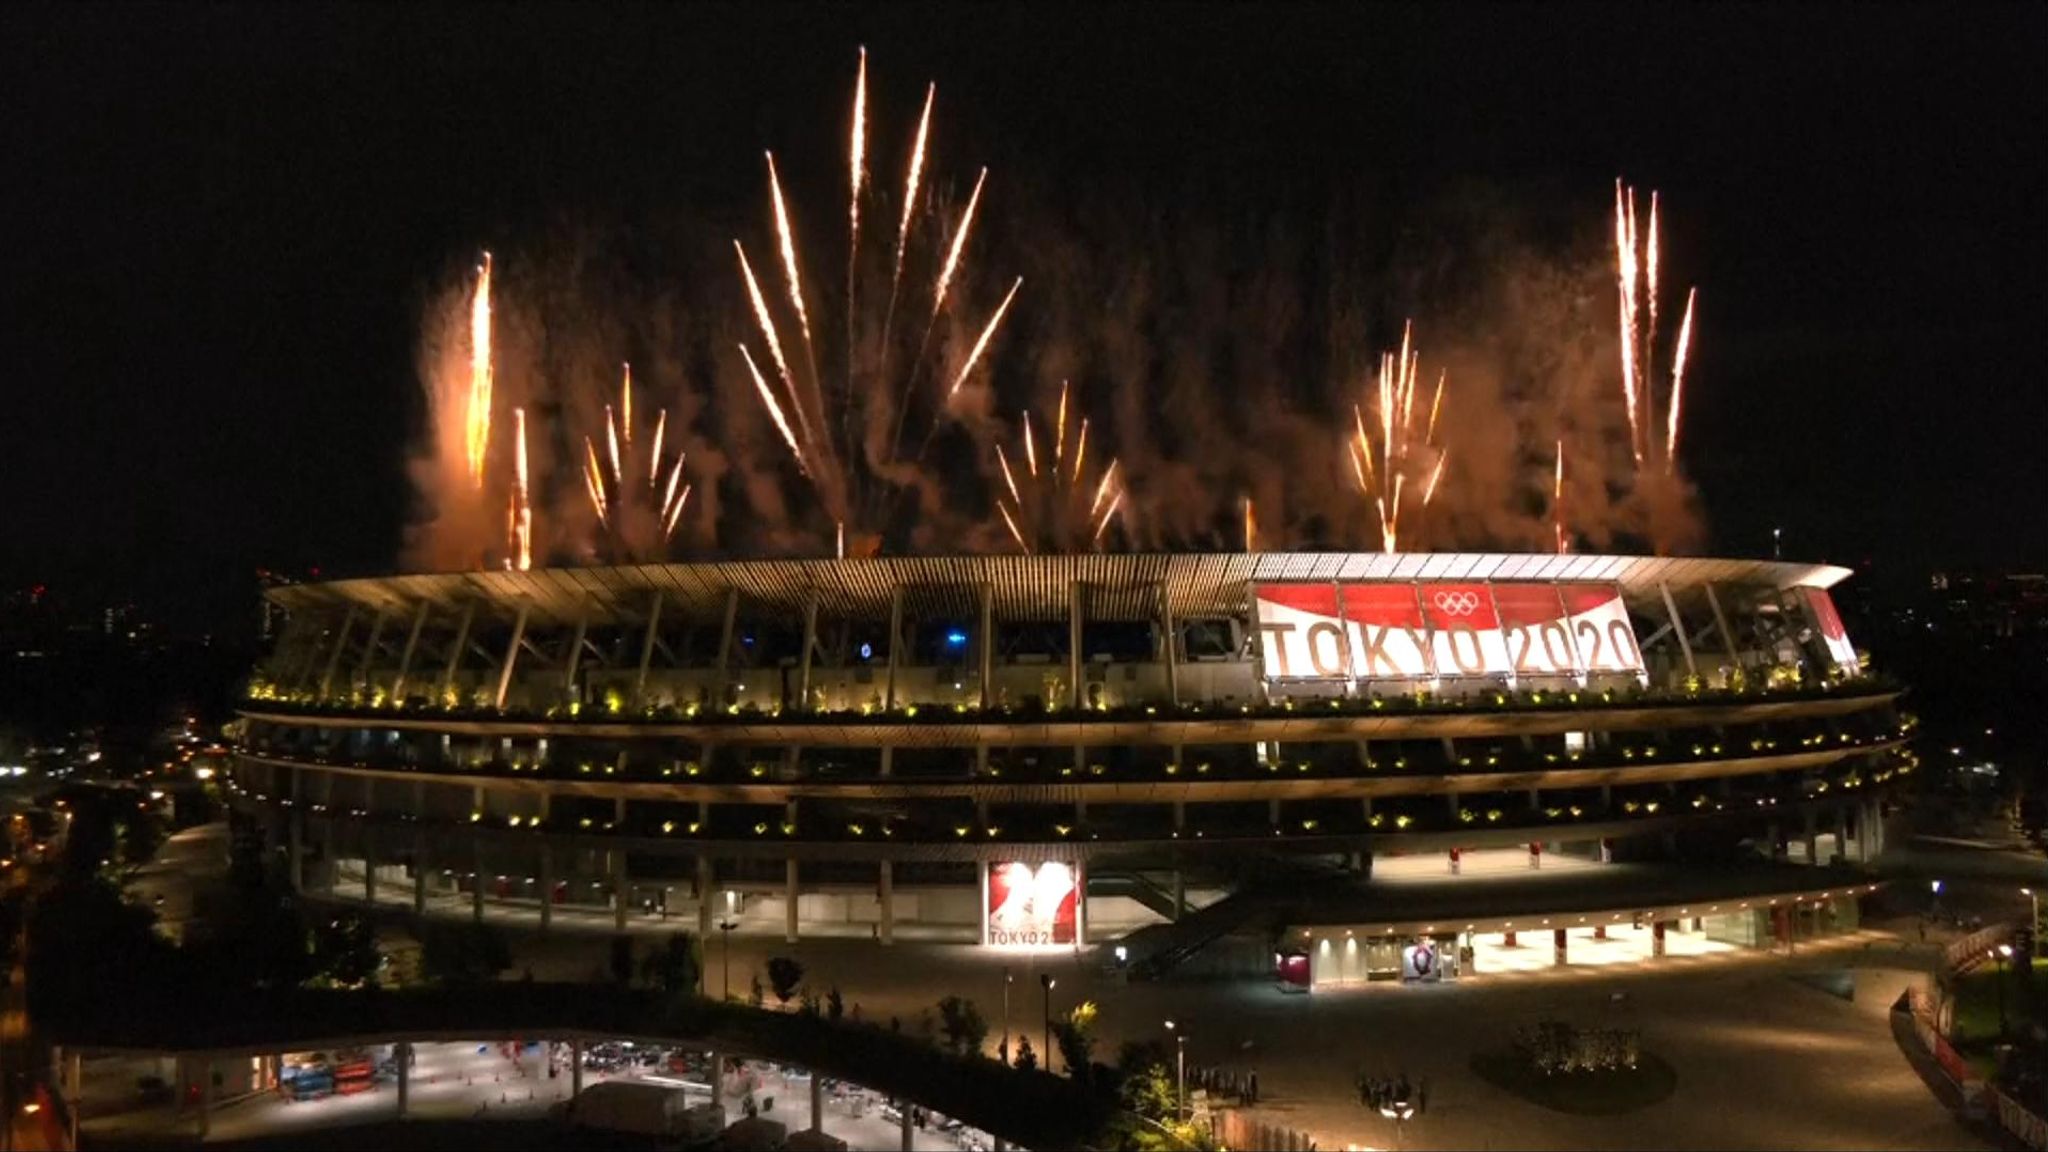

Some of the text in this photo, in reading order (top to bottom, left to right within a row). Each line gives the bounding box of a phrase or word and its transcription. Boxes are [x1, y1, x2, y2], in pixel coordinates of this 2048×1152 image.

[1260, 619, 1641, 677] TOKYO 2020
[990, 931, 1038, 945] TOKYO
